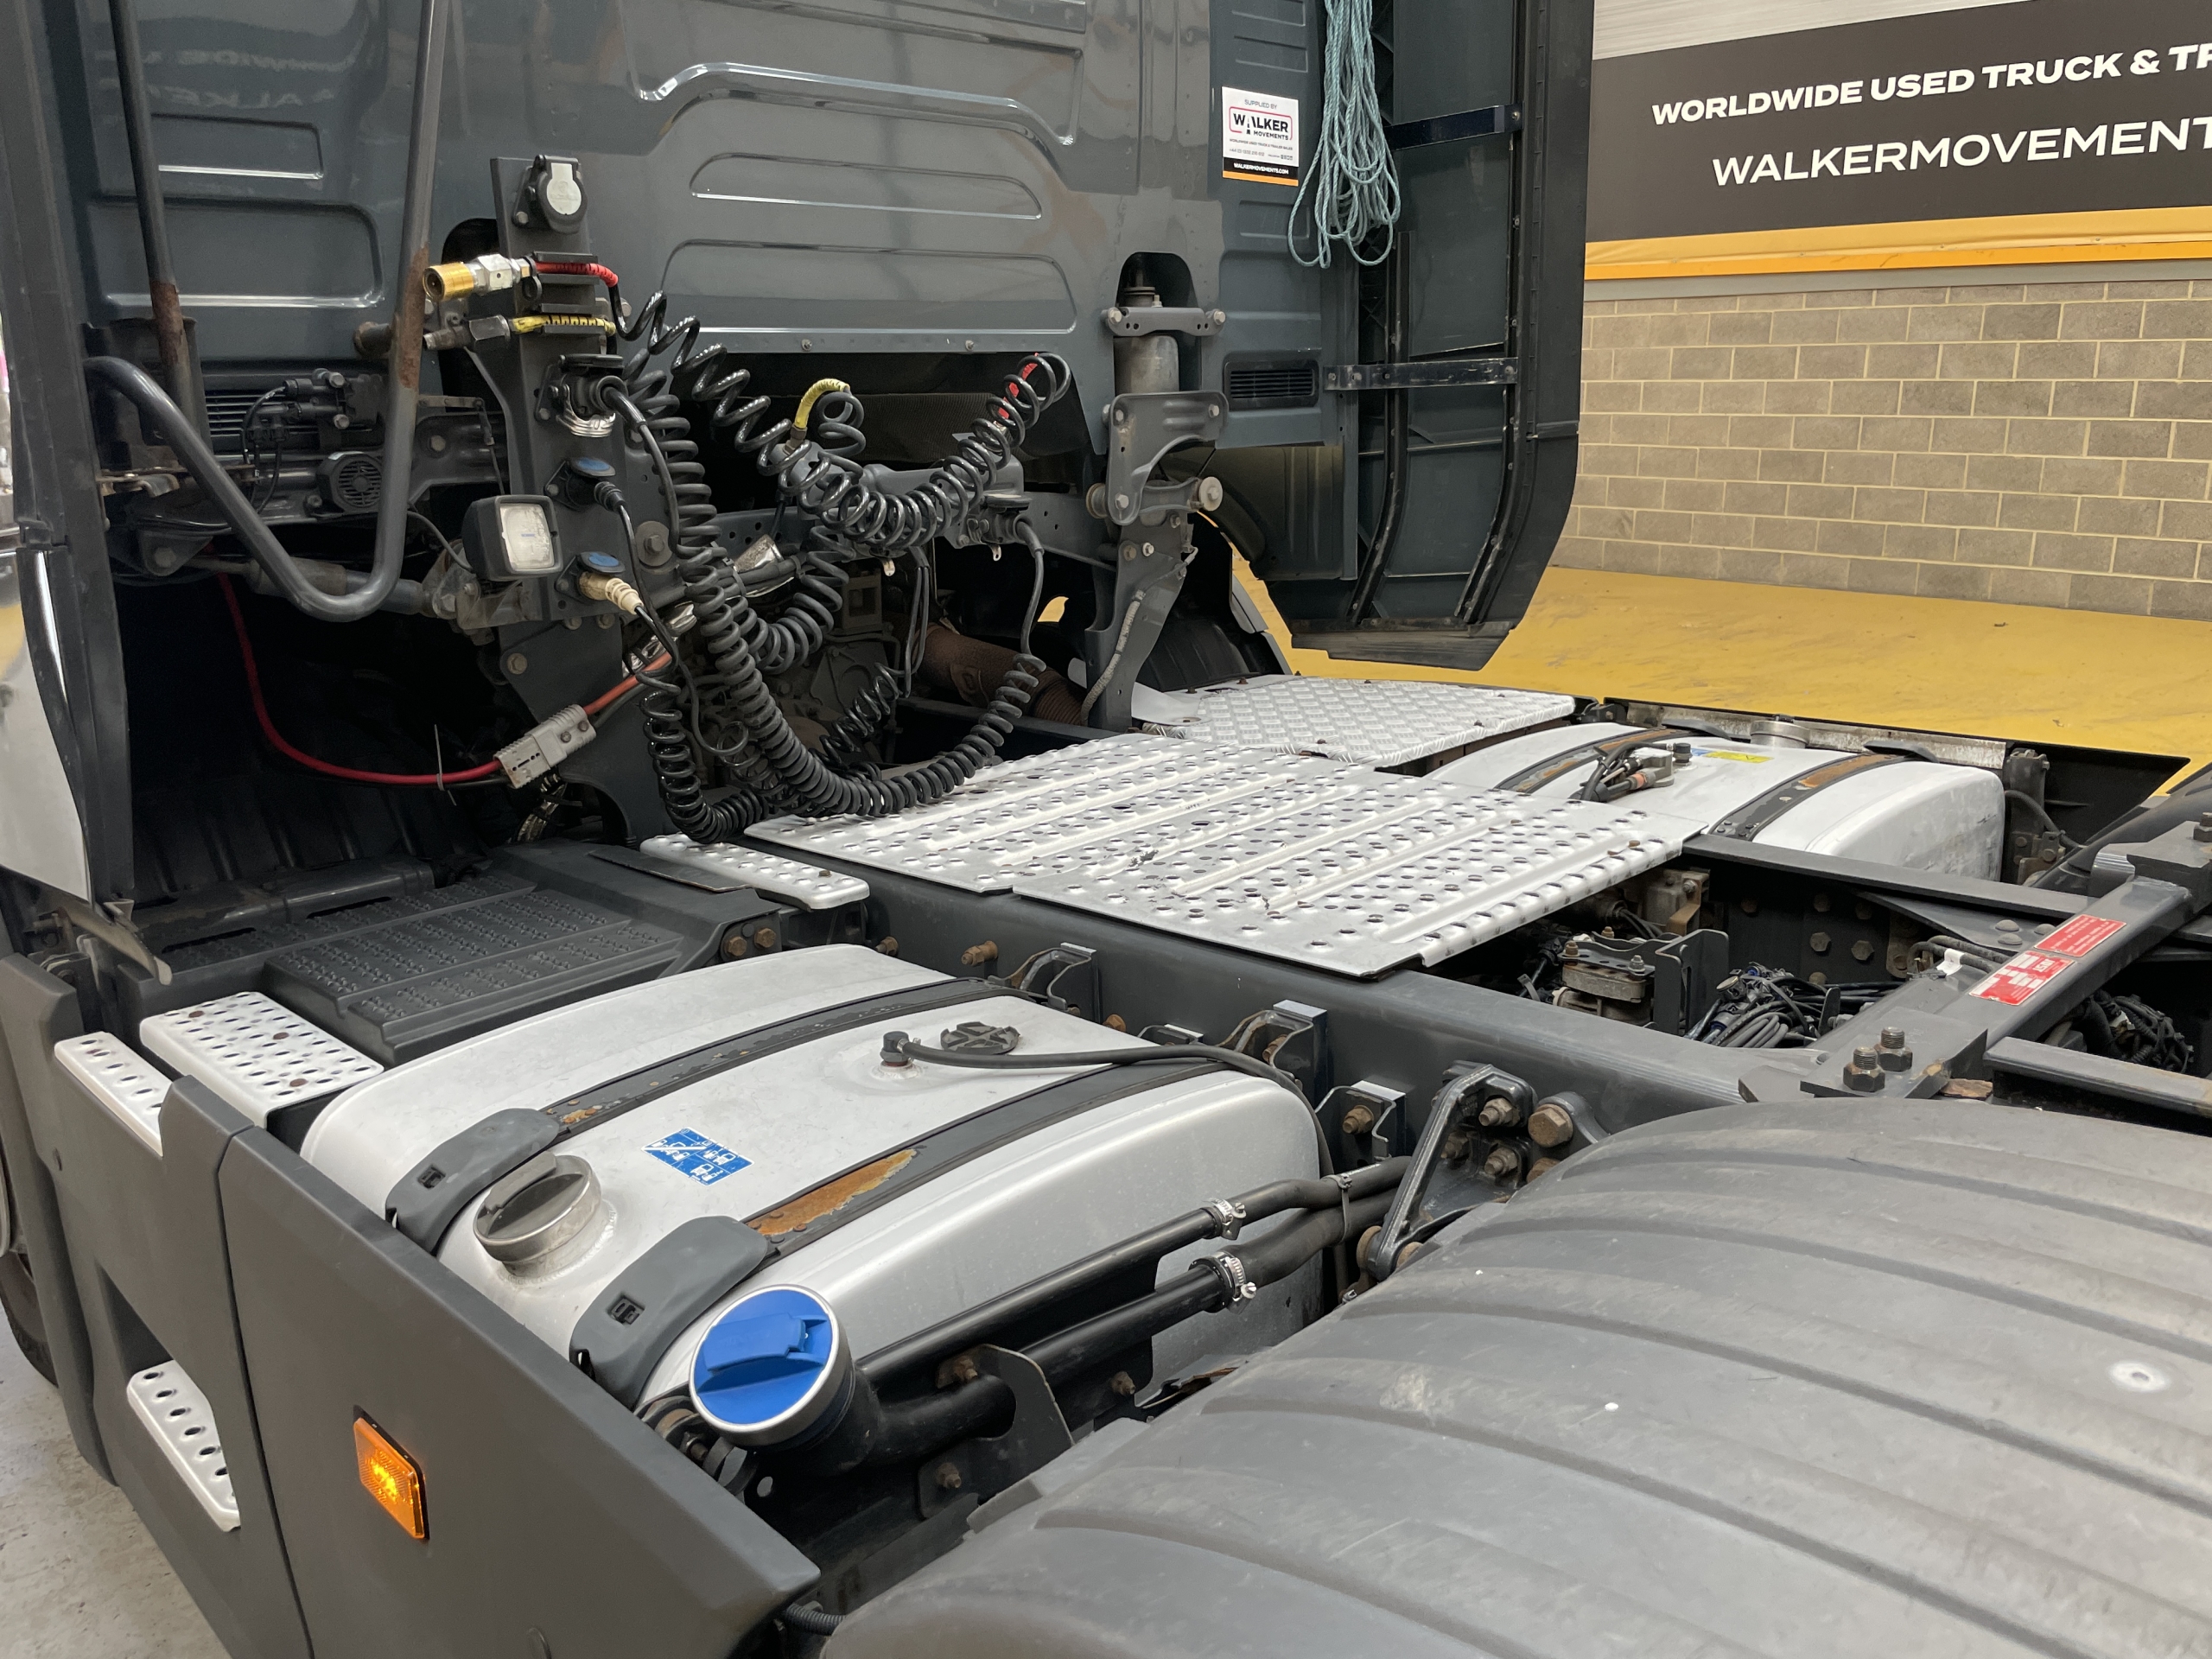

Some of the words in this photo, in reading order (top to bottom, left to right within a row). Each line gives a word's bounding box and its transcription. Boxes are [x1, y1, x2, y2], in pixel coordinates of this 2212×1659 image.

[1652, 81, 1863, 124] WORLDWIDE
[1870, 69, 1975, 101] USED
[1981, 52, 2124, 89] TRUCK
[2129, 48, 2161, 75] &
[1244, 99, 1269, 108] SUPPLIED
[1233, 113, 1288, 133] WALKER
[1253, 130, 1288, 140] MOVEMENTS
[1234, 162, 1288, 174] WALKERMOVEMENTS.COM
